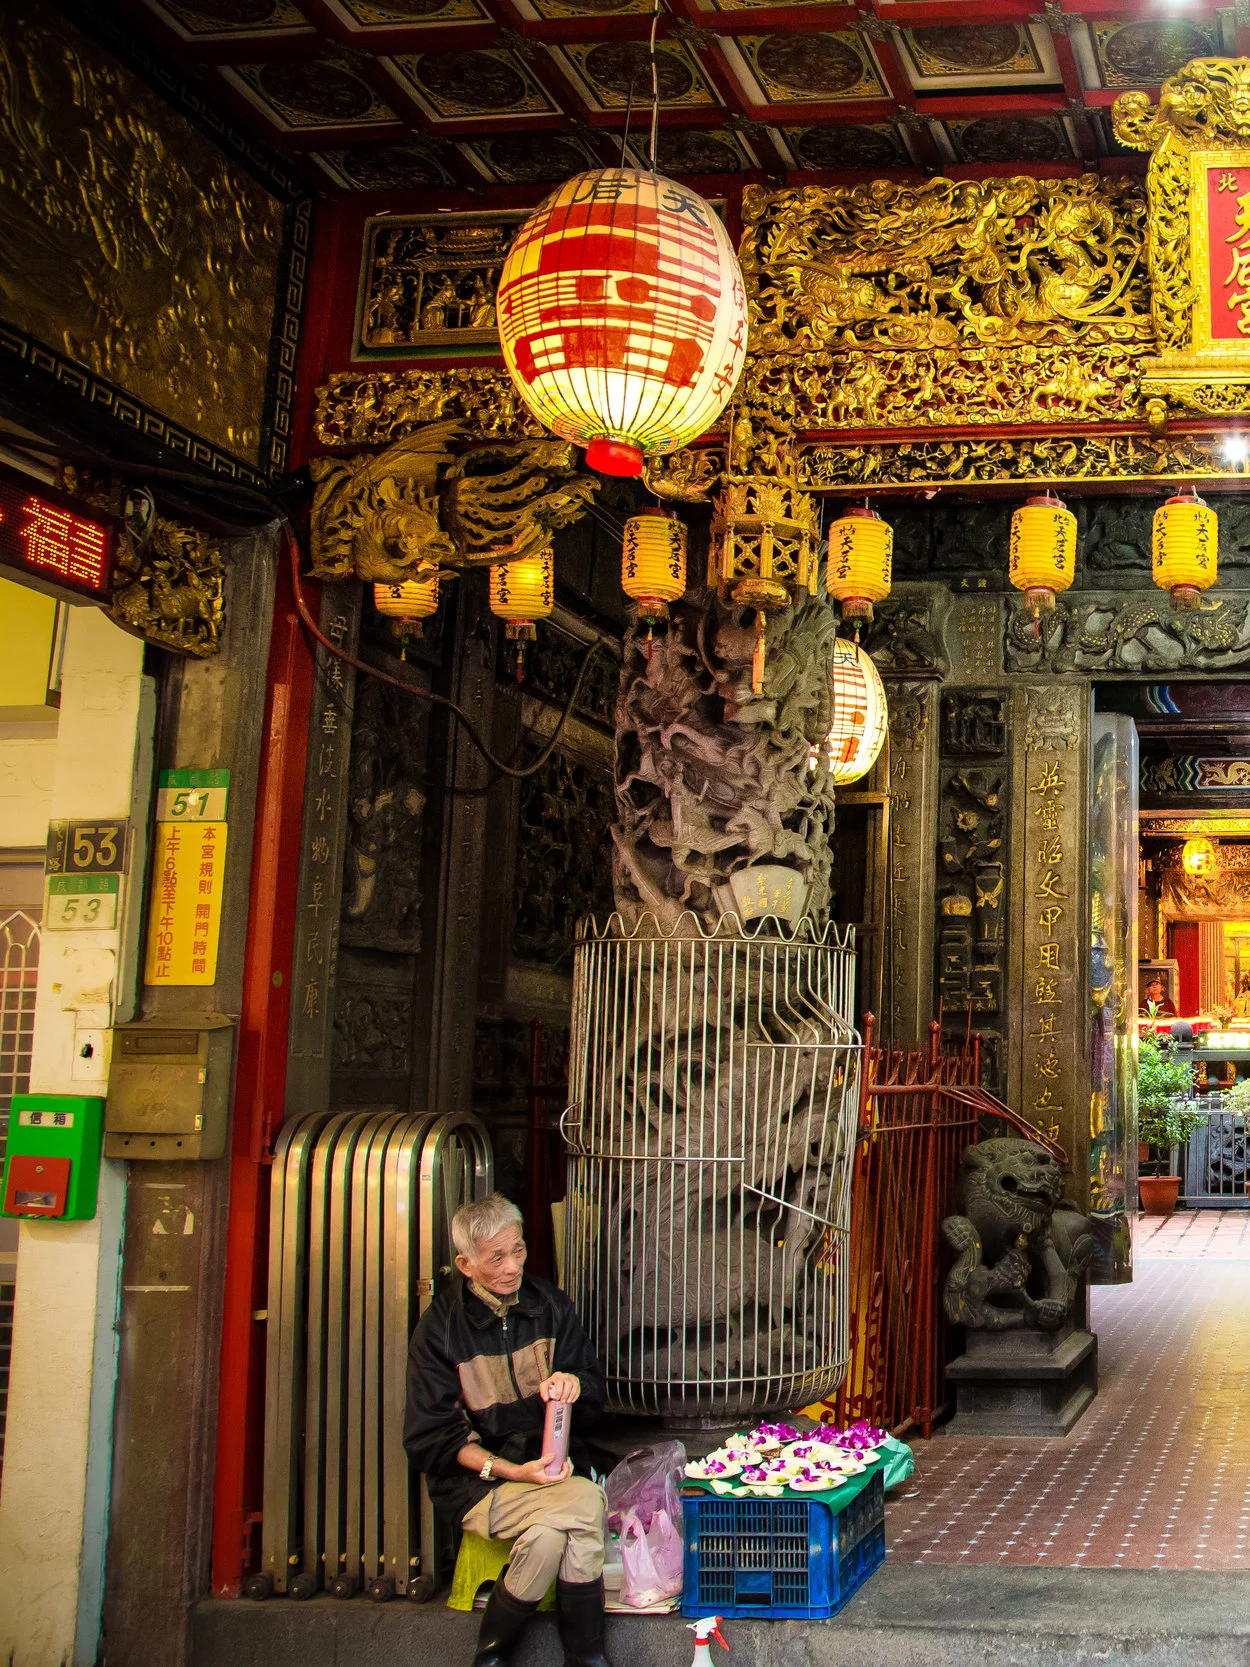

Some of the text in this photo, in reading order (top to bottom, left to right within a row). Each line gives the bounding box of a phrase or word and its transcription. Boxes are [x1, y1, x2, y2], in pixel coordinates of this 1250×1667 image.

[19, 496, 105, 588] 福壽
[836, 536, 854, 580] 天后宮
[1052, 526, 1068, 571] 天后宮
[1195, 523, 1210, 570] 天后宮
[171, 792, 210, 816] 51
[73, 827, 119, 868] 53
[61, 898, 102, 924] 53
[155, 825, 181, 978] 上午6點至下午10點止
[191, 826, 217, 974] 本宮規則 開門時間
[30, 1111, 67, 1126] 信箱
